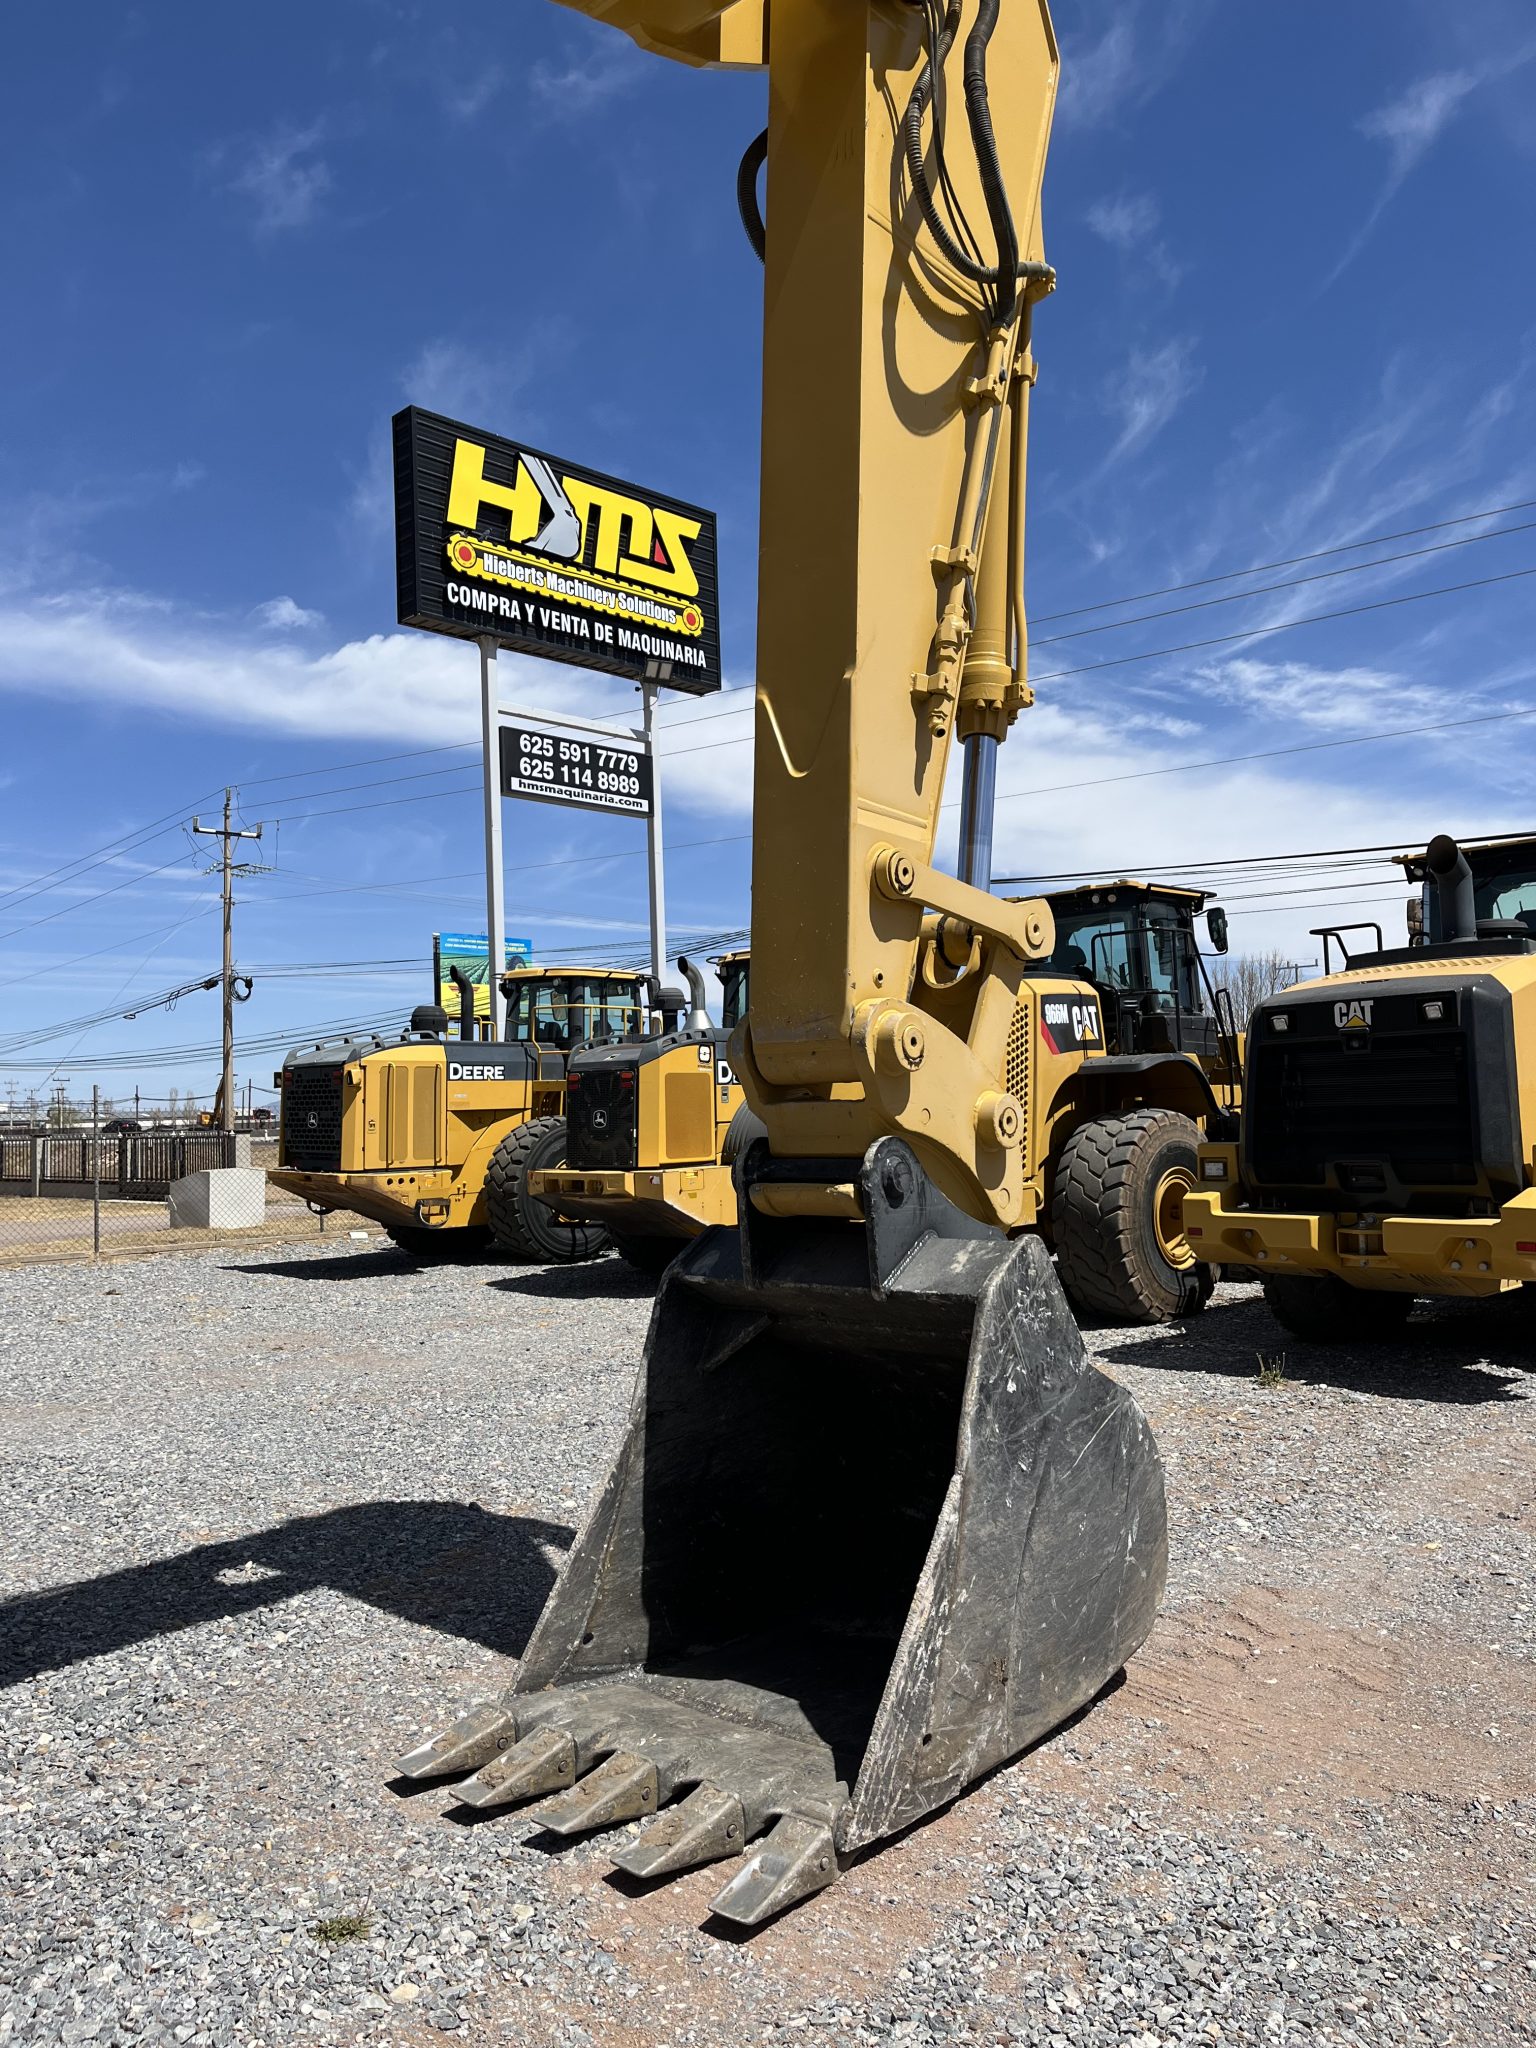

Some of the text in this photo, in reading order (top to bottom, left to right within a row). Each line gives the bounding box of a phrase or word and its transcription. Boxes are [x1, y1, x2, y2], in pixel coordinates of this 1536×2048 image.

[483, 552, 677, 625] Hieberts Machinery Solutions
[447, 582, 707, 668] COMPRA Y VENTA DE MAQUINARIA
[519, 733, 639, 774] 625 591 7779
[518, 779, 643, 808] hmsmaquinaria.com
[519, 757, 640, 796] 625 114 8989
[1044, 1003, 1100, 1041] 966M CAT
[1333, 1000, 1374, 1028] CAT
[449, 1062, 505, 1080] DEERE
